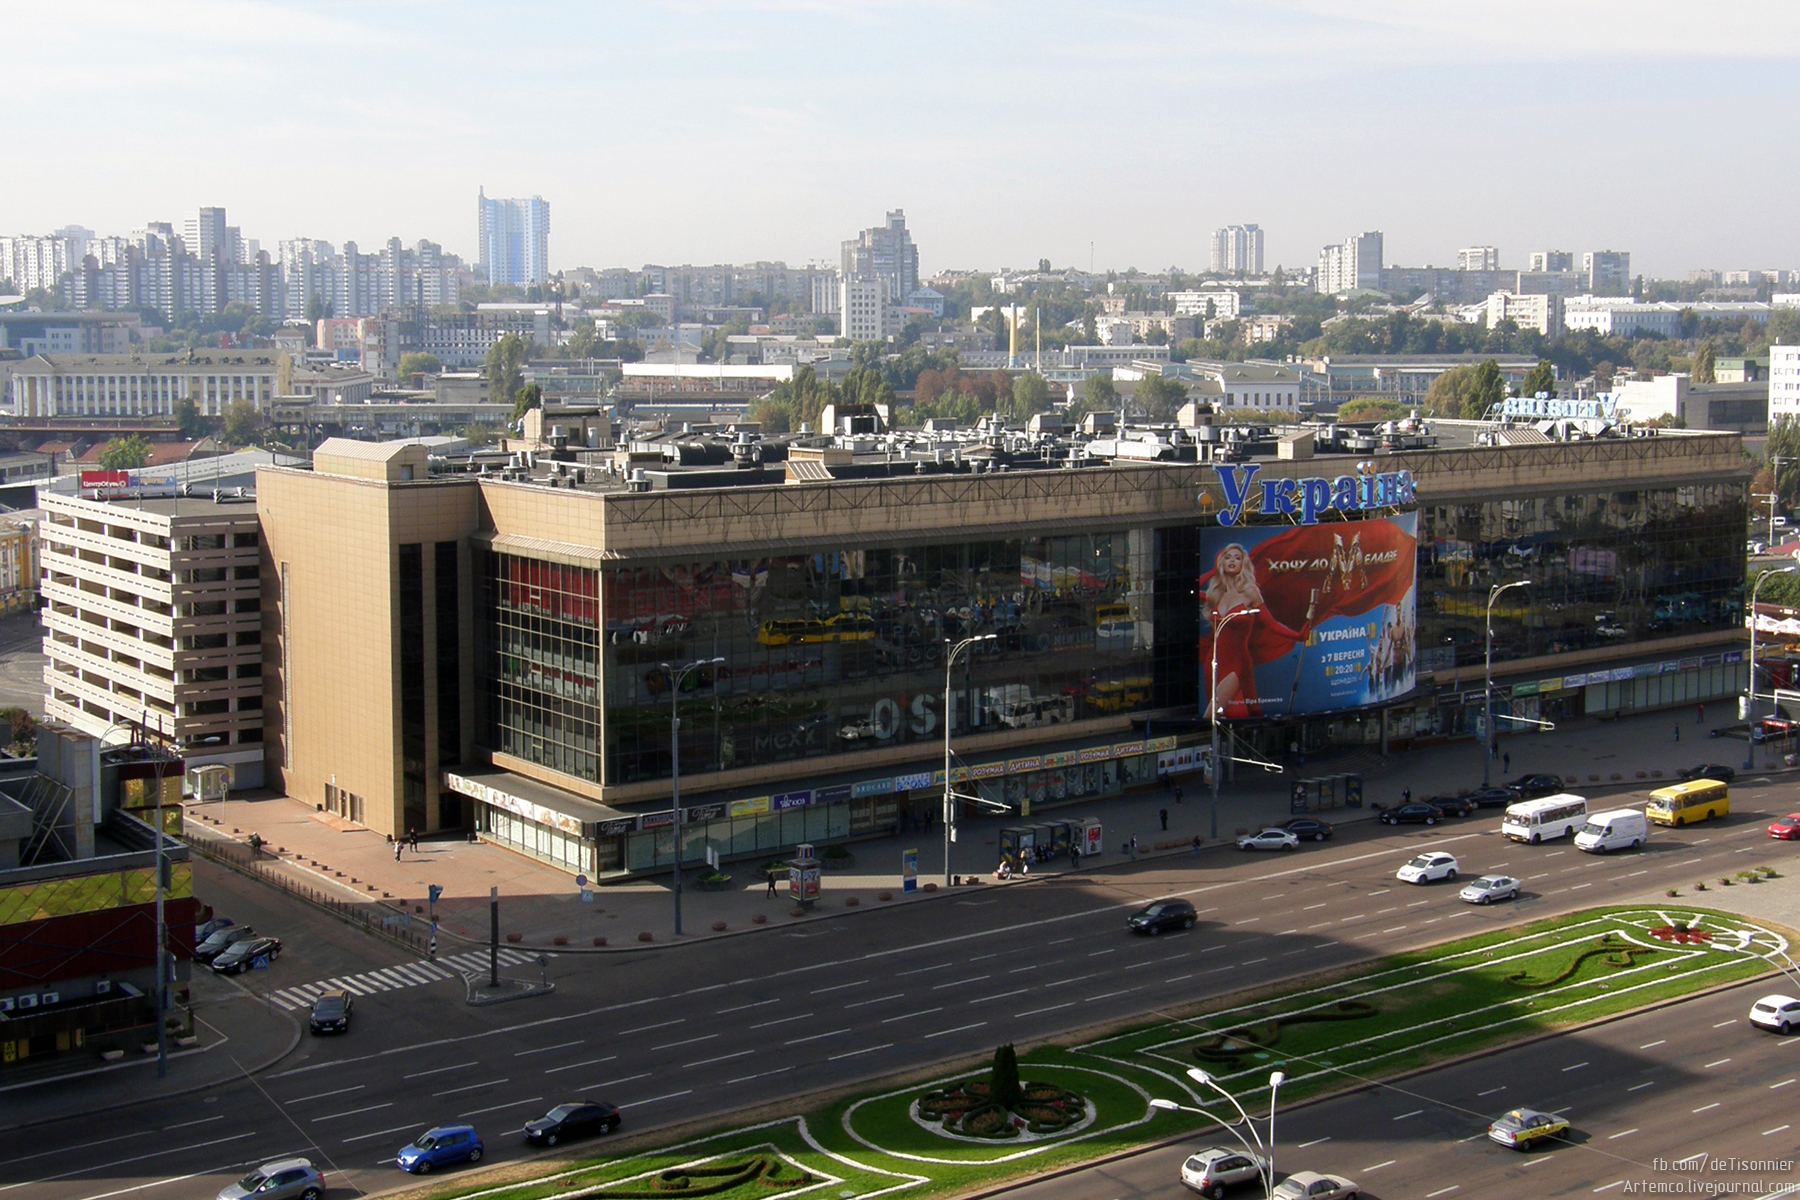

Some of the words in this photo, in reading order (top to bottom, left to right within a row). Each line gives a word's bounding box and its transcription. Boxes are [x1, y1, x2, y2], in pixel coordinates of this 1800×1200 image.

[1212, 461, 1414, 527] Україна
[1267, 558, 1308, 573] ХОЧУ
[1308, 558, 1328, 571] ДО
[1319, 626, 1366, 642] УКРАЇНА
[1327, 653, 1333, 662] 7
[1334, 649, 1365, 662] ВЕРЕСНЯ
[1335, 664, 1354, 674] 20:20
[1115, 744, 1143, 756] ДИТИНА
[973, 765, 1004, 777] РОЗУМНА
[1010, 759, 1040, 772] ДИТИНА
[856, 781, 892, 793] BROCARD
